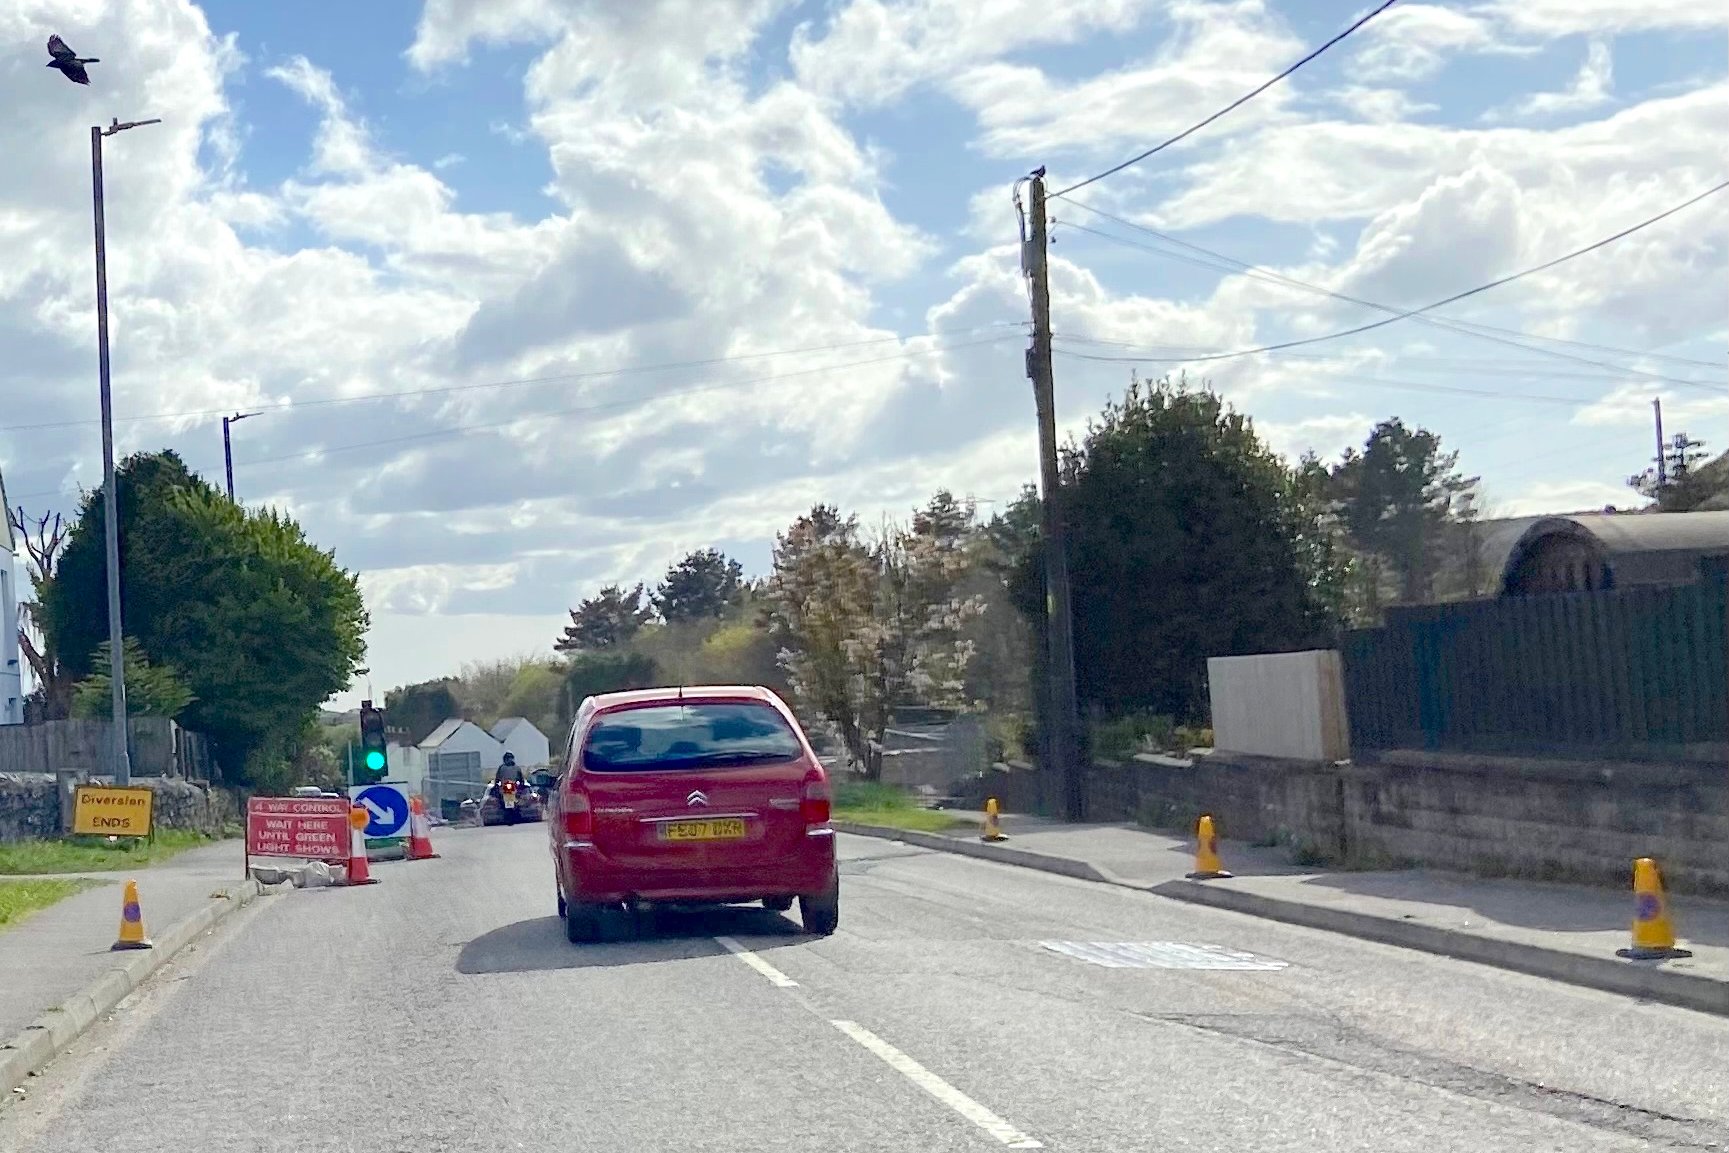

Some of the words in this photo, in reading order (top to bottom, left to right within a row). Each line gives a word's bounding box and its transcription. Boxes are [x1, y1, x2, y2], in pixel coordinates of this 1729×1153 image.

[82, 794, 146, 807] Diversion
[255, 802, 263, 811] 4
[268, 802, 289, 812] WAY
[293, 803, 342, 813] CONTROL
[93, 816, 130, 828] ENDS
[266, 819, 293, 829] WAIT
[297, 820, 329, 830] HERE
[258, 830, 291, 841] UNTIL
[295, 832, 336, 843] GREEN
[257, 842, 291, 852] LIGHT
[295, 844, 340, 854] SHOWS
